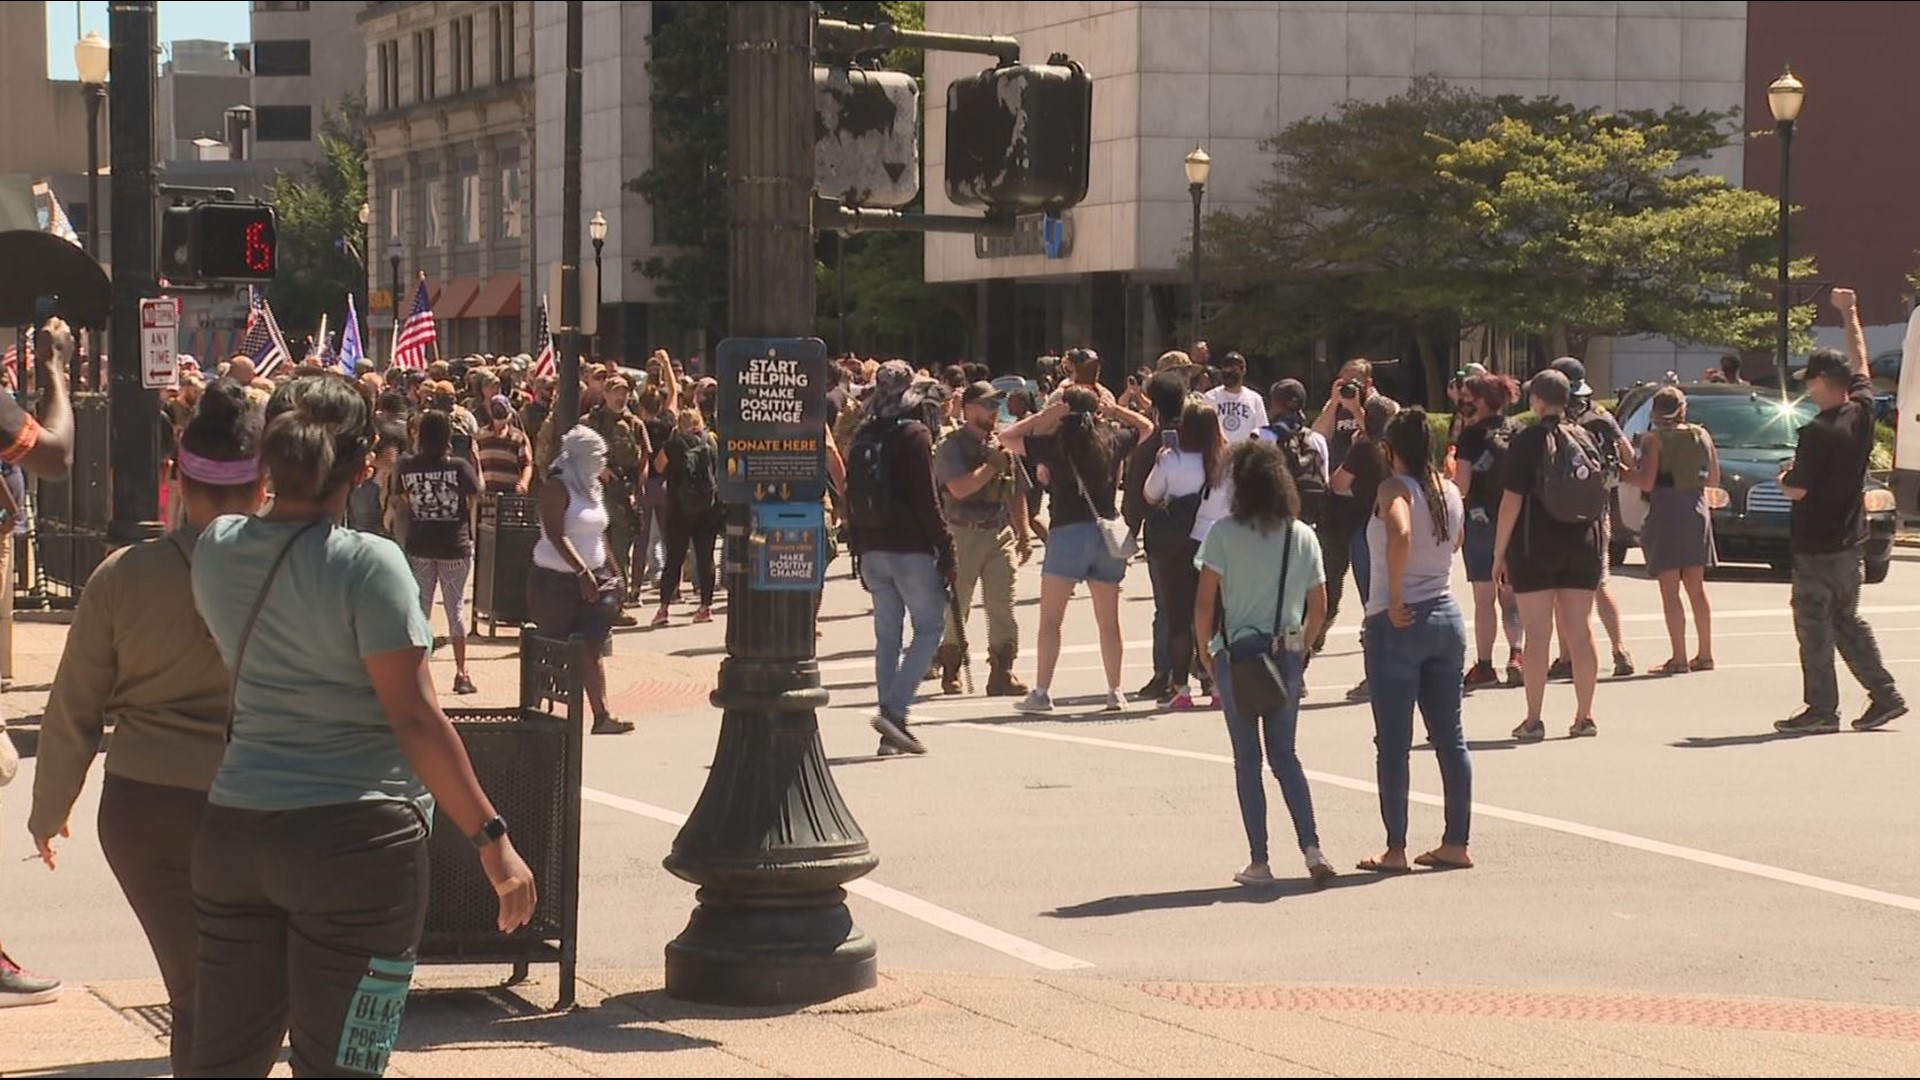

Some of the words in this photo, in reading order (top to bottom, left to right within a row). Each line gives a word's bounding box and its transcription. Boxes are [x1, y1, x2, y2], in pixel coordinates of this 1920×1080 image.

[245, 221, 271, 272] 6
[151, 332, 169, 346] ANY
[150, 349, 170, 364] TIME
[749, 359, 798, 373] START
[738, 371, 808, 387] HELPING
[759, 388, 794, 399] MAKE
[740, 398, 803, 411] POSITIVE
[1217, 401, 1250, 419] NIKE
[741, 410, 801, 423] CHANGE
[727, 440, 780, 451] DONATE
[782, 440, 817, 451] HERE
[779, 553, 804, 561] MAKE
[769, 560, 813, 570] POSITIVE
[770, 568, 812, 578] CHANGE
